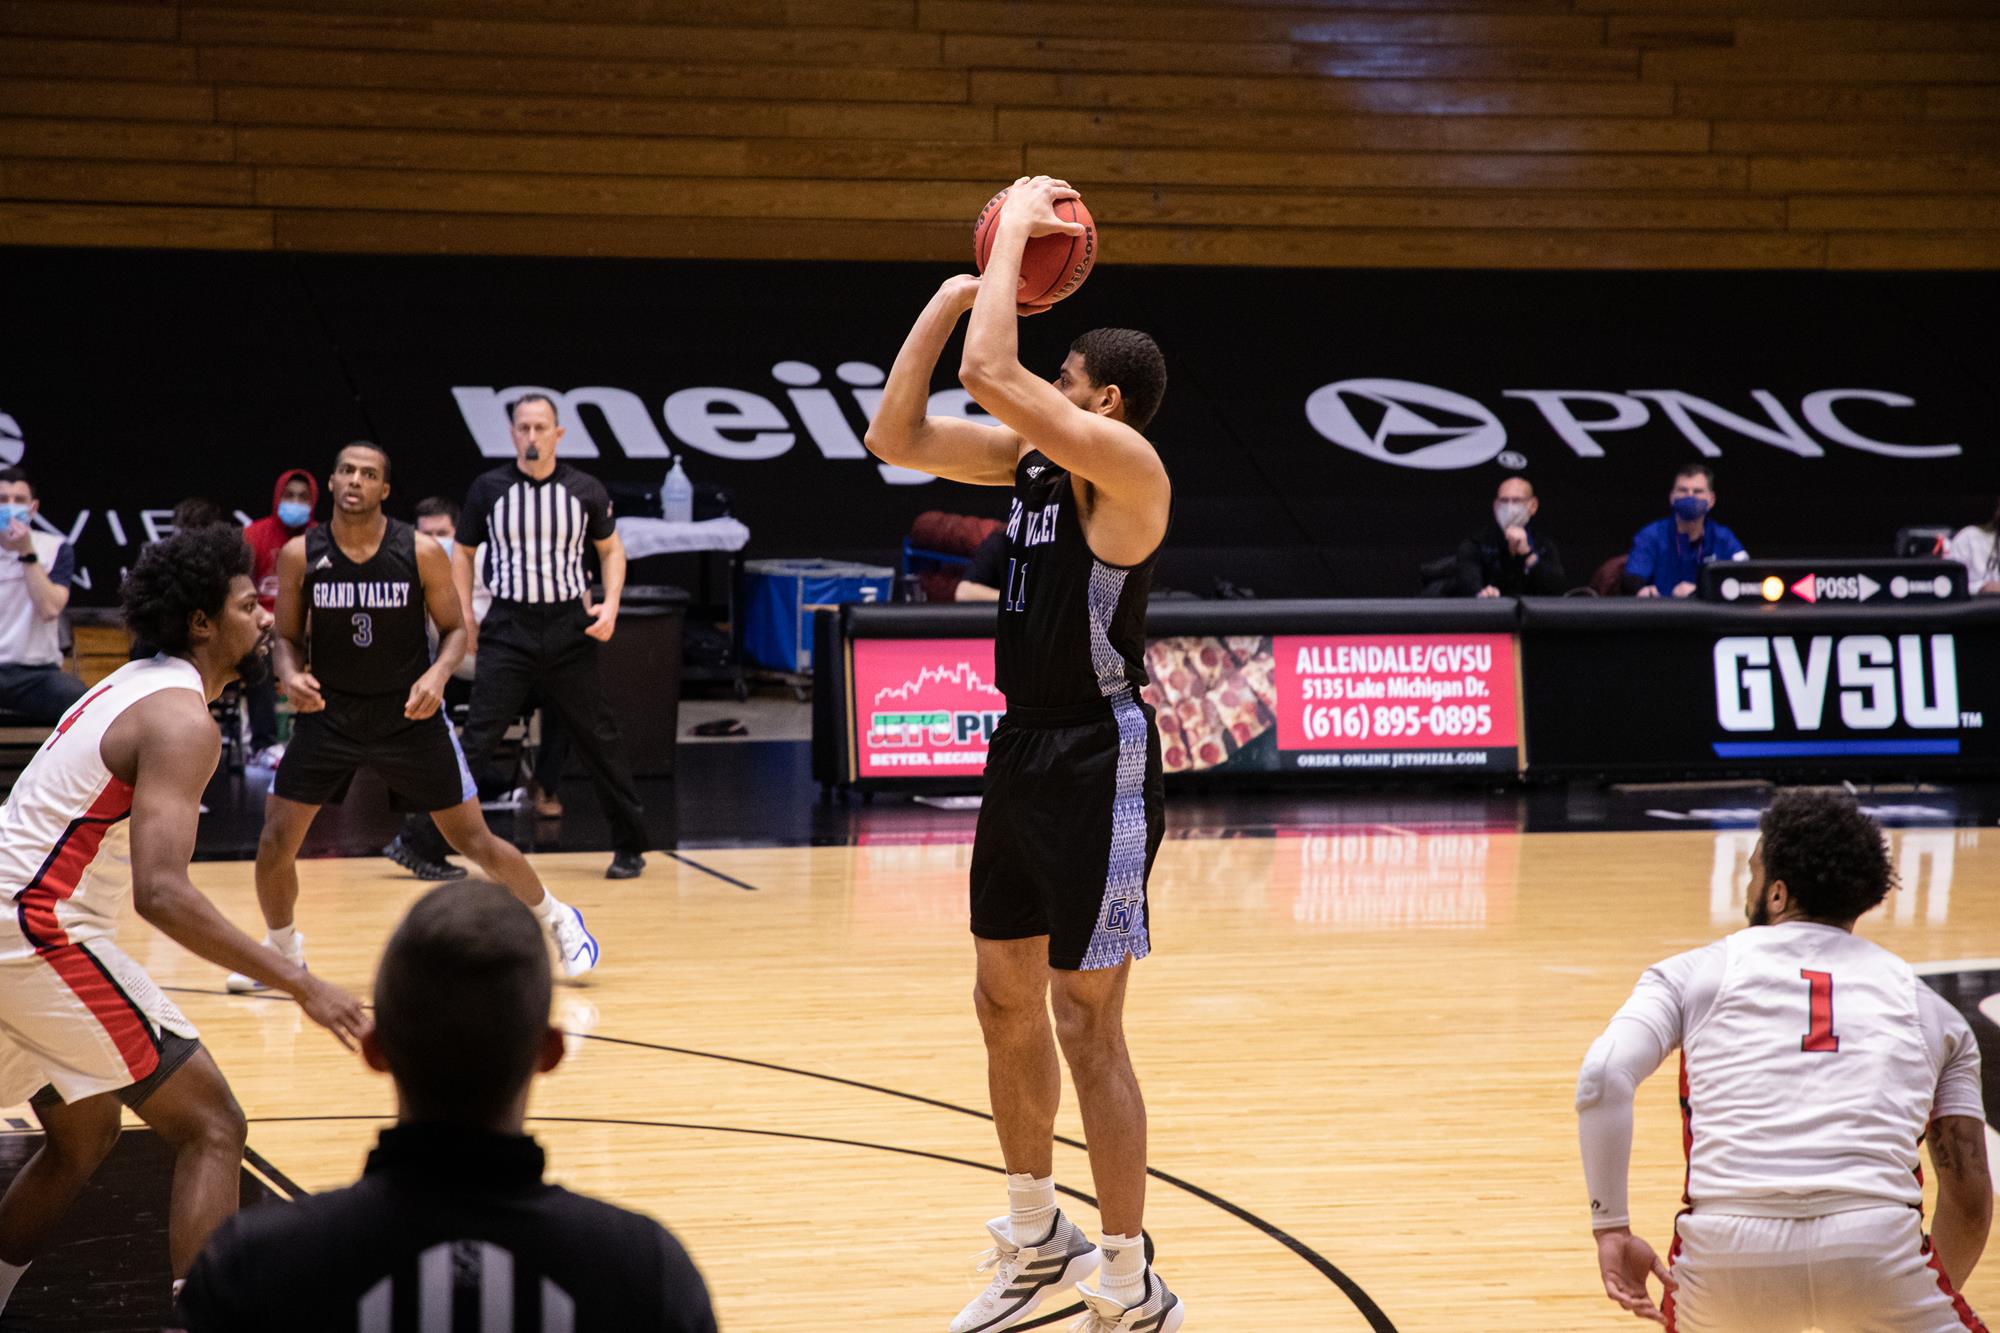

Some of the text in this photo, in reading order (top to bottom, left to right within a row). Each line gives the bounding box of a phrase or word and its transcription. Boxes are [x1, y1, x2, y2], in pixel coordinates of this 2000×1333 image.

[1502, 389, 1962, 458] PNC
[313, 582, 410, 608] GRAND VALLEY
[1815, 576, 1859, 600] POSS
[351, 612, 373, 648] 3
[1296, 644, 1492, 675] ALLENDALE/GVSU
[1302, 675, 1490, 703] 5135 Lake Michigan Dr.
[1713, 633, 1960, 731] GVSU
[1303, 703, 1492, 740] (616) 895-0895
[1297, 751, 1488, 768] ORDER ONLINE JETSPIZZA.COM
[1105, 897, 1139, 934] GV
[1799, 967, 1839, 1054] 1
